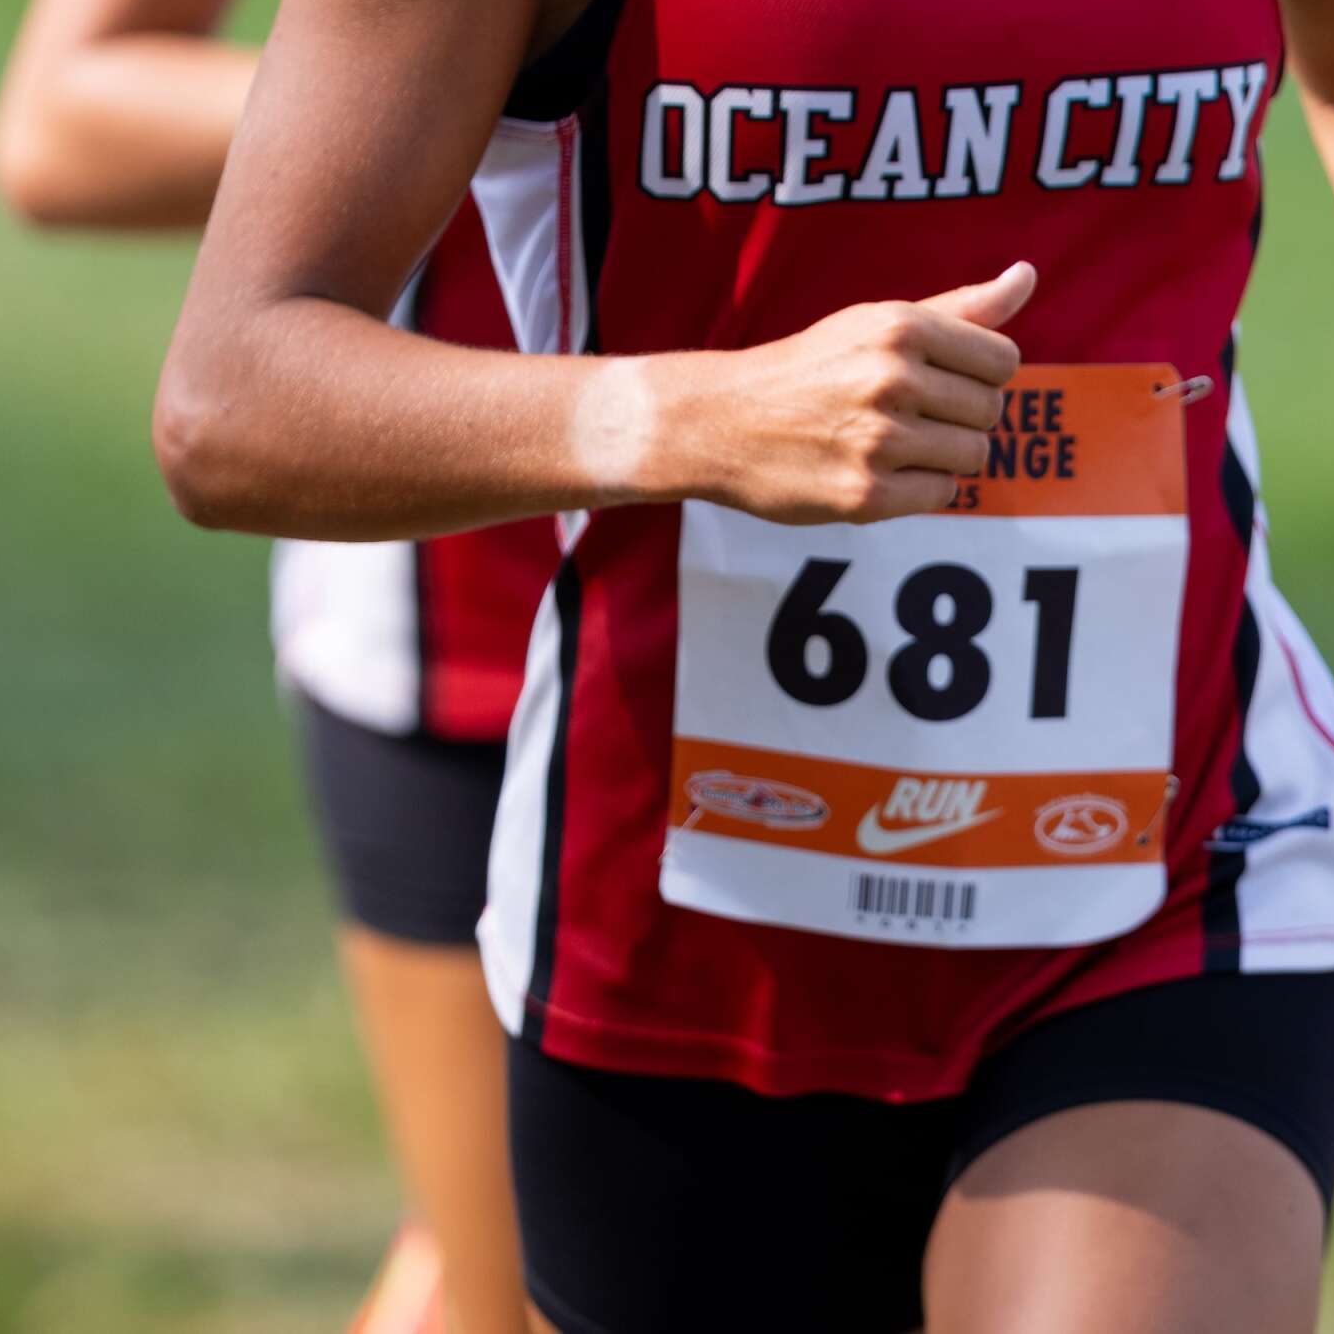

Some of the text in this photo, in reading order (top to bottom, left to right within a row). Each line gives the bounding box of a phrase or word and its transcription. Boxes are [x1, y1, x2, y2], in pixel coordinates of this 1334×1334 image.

[638, 60, 1266, 205] OCEAN CITY
[957, 436, 1075, 479] NGE
[765, 556, 1080, 722] 681
[883, 776, 988, 824] RUN
